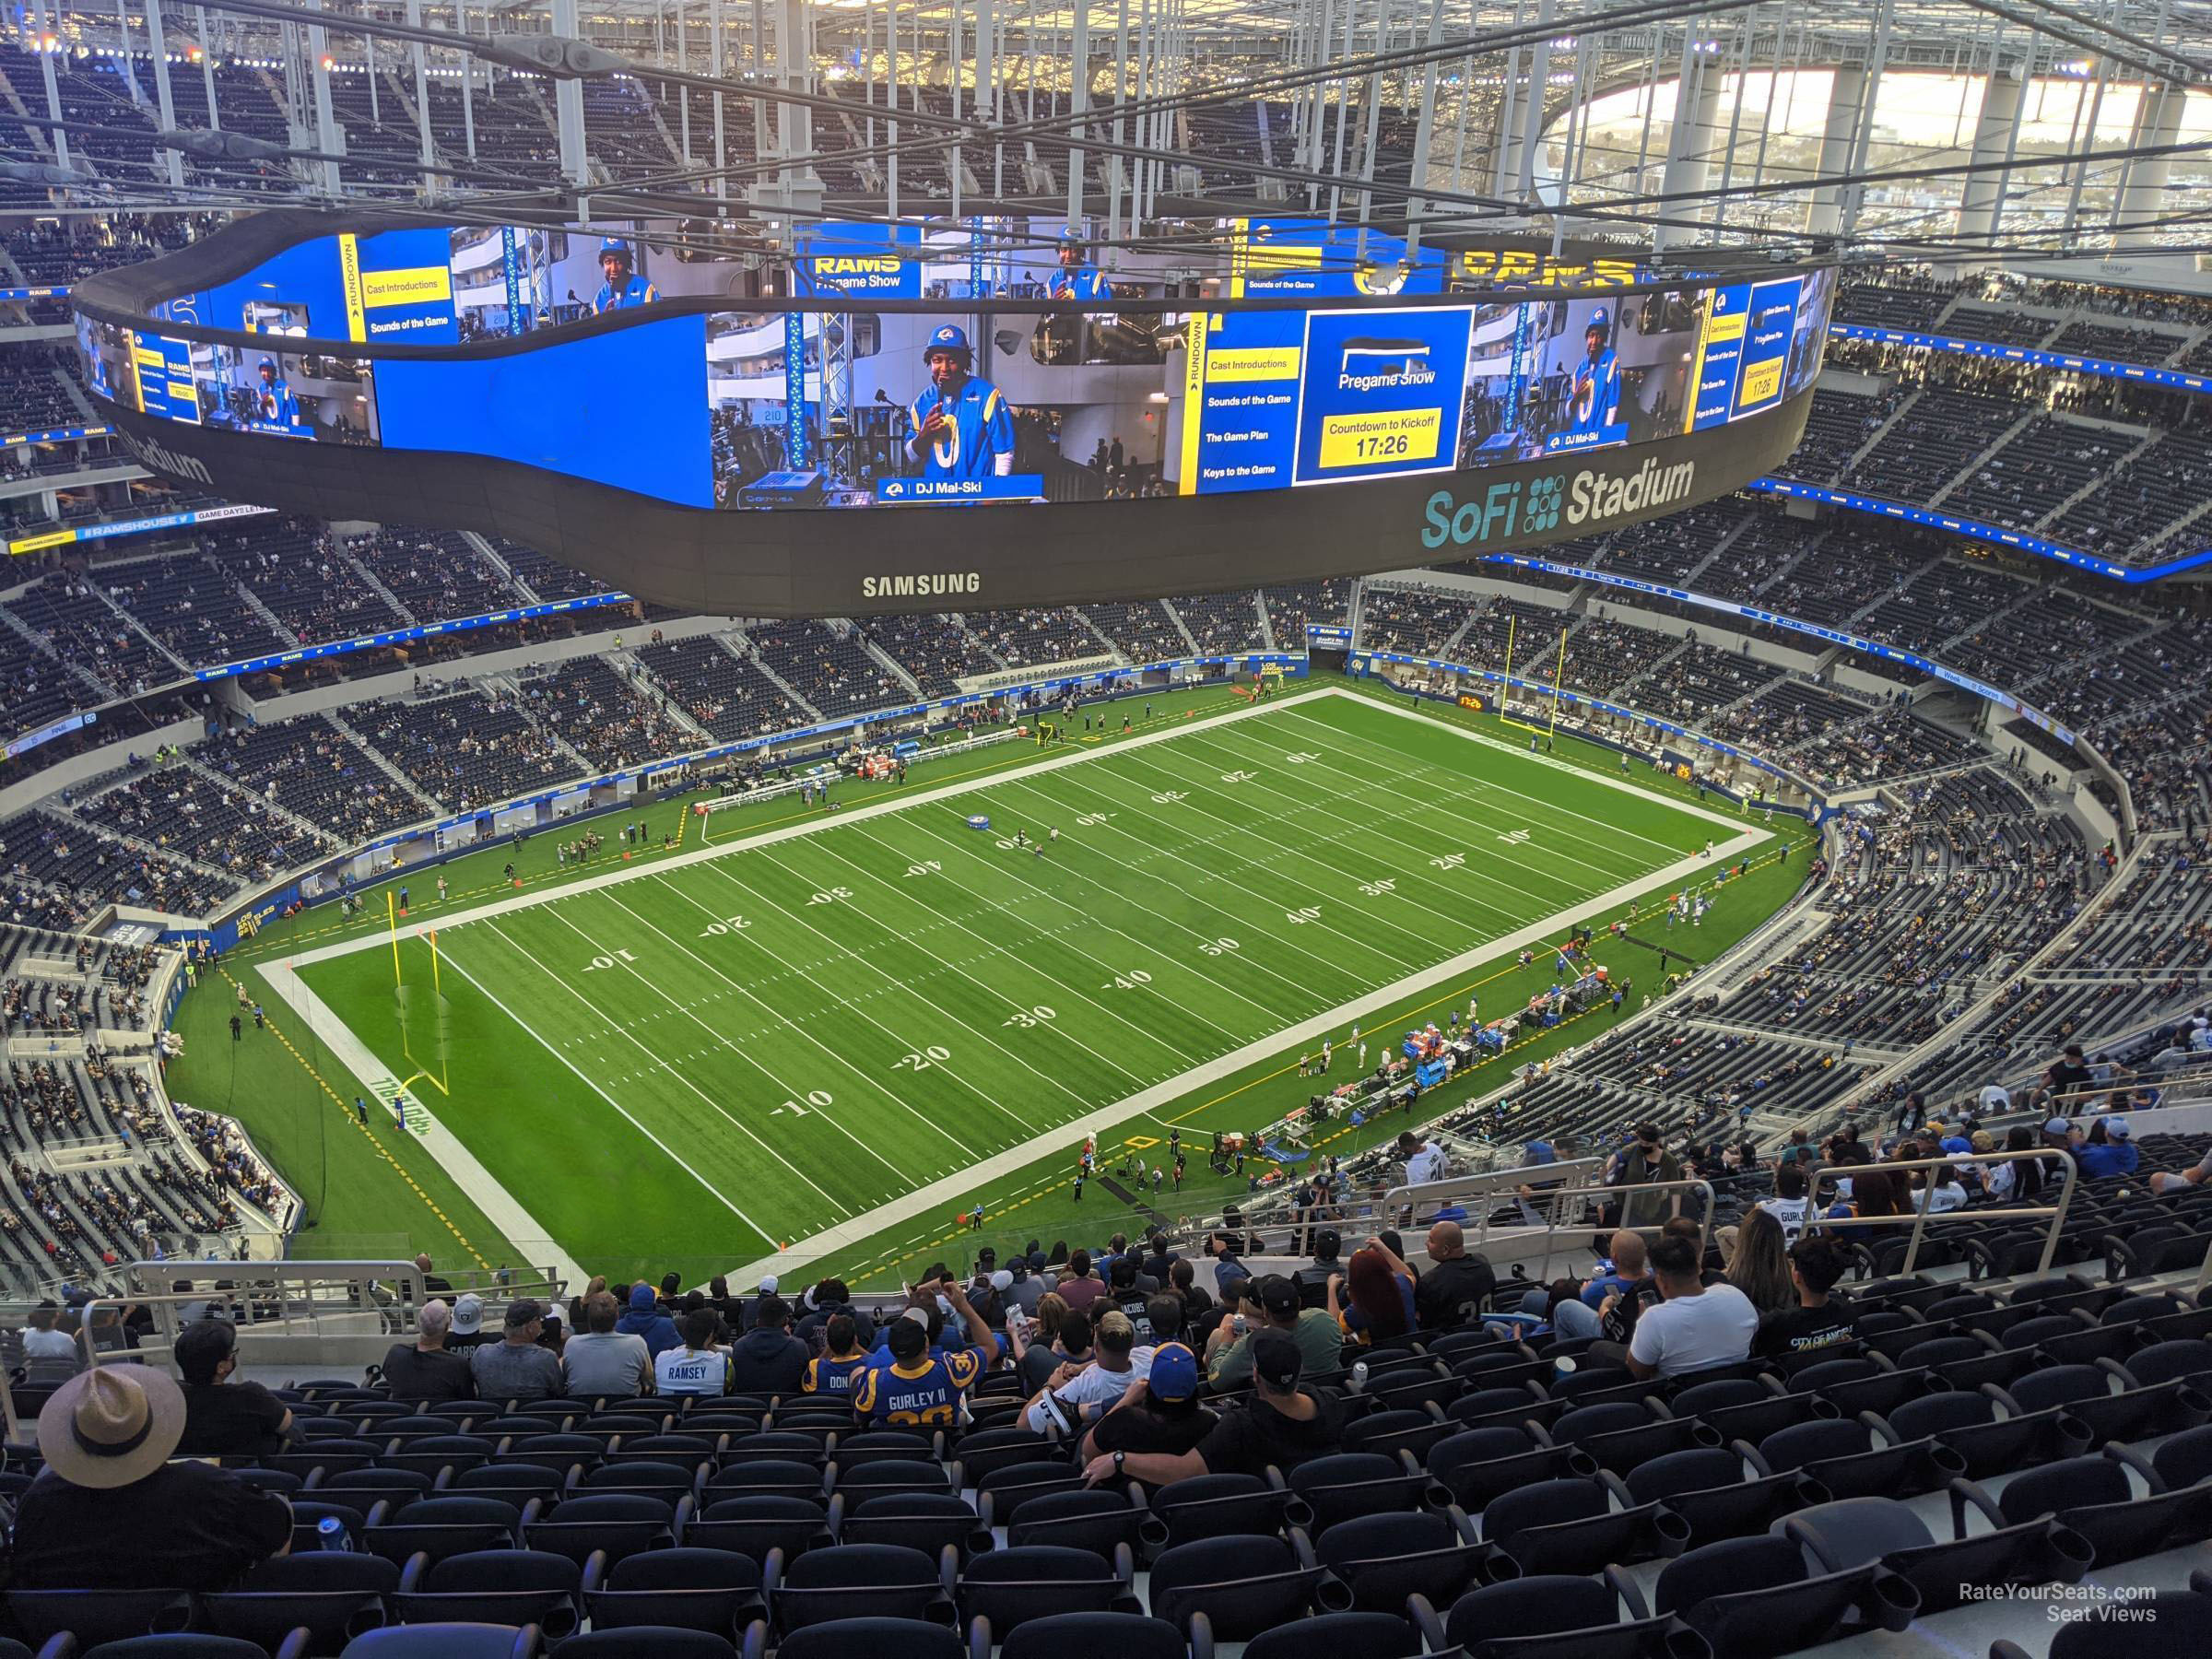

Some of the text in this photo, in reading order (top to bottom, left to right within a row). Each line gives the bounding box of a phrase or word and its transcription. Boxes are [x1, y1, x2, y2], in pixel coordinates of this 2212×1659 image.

[816, 255, 900, 274] RAMS
[345, 243, 358, 306] RUNDOWN
[869, 275, 900, 288] Show
[367, 280, 438, 295] Cast Introductions
[1295, 281, 1315, 289] Game
[371, 316, 449, 333] Sounds of the Game
[1191, 321, 1202, 380] RUNDOWN
[1211, 359, 1287, 371] Cast Introductions
[1339, 372, 1397, 392] Pregame
[1754, 379, 1771, 397] 17:26
[1208, 394, 1291, 407] Sounds of the Game
[765, 411, 781, 421] 210
[1329, 416, 1434, 434] Countdown to Kickoff
[6, 436, 27, 444] RAMS
[1206, 430, 1268, 442] The Game Plan
[1565, 430, 1599, 445] DJ Mal-Ski
[1357, 435, 1408, 457] 17:26
[1204, 465, 1276, 479] Keys to the Game
[916, 481, 982, 494] DJ Mal-Ski
[1421, 457, 1695, 548] SoFi Stadium
[198, 511, 222, 520] GAME
[85, 516, 177, 538] #RAMSHOUSE
[863, 572, 980, 597] SAMSUNG
[424, 625, 442, 633] RAMS
[355, 639, 374, 647] RAMS
[281, 653, 303, 662] RAMS
[206, 668, 228, 677] RAMS
[1944, 671, 1961, 683] Week
[1460, 696, 1481, 710] 17:26
[1221, 770, 1253, 784] 20
[1677, 765, 1689, 778] 25
[1151, 791, 1184, 805] 30
[1077, 812, 1109, 827] 40
[1497, 830, 1527, 846] 10
[909, 859, 942, 877] 40
[1430, 854, 1462, 871] 20
[812, 886, 853, 904] 30
[1359, 880, 1393, 897] 30
[236, 912, 252, 924] LOS
[238, 905, 275, 931] ANELES
[1286, 908, 1320, 925] 40
[708, 914, 752, 935] 20
[1198, 937, 1241, 957] 50
[592, 947, 638, 970] 10
[1111, 970, 1153, 991] 40
[1011, 1005, 1057, 1030] 30
[900, 1044, 951, 1071] 20
[782, 1089, 833, 1118] 10
[1782, 1211, 1809, 1222] GURLE
[1791, 1336, 1812, 1347] CITY
[668, 1366, 707, 1381] RAMSEY
[888, 1388, 946, 1410] GURLEY II
